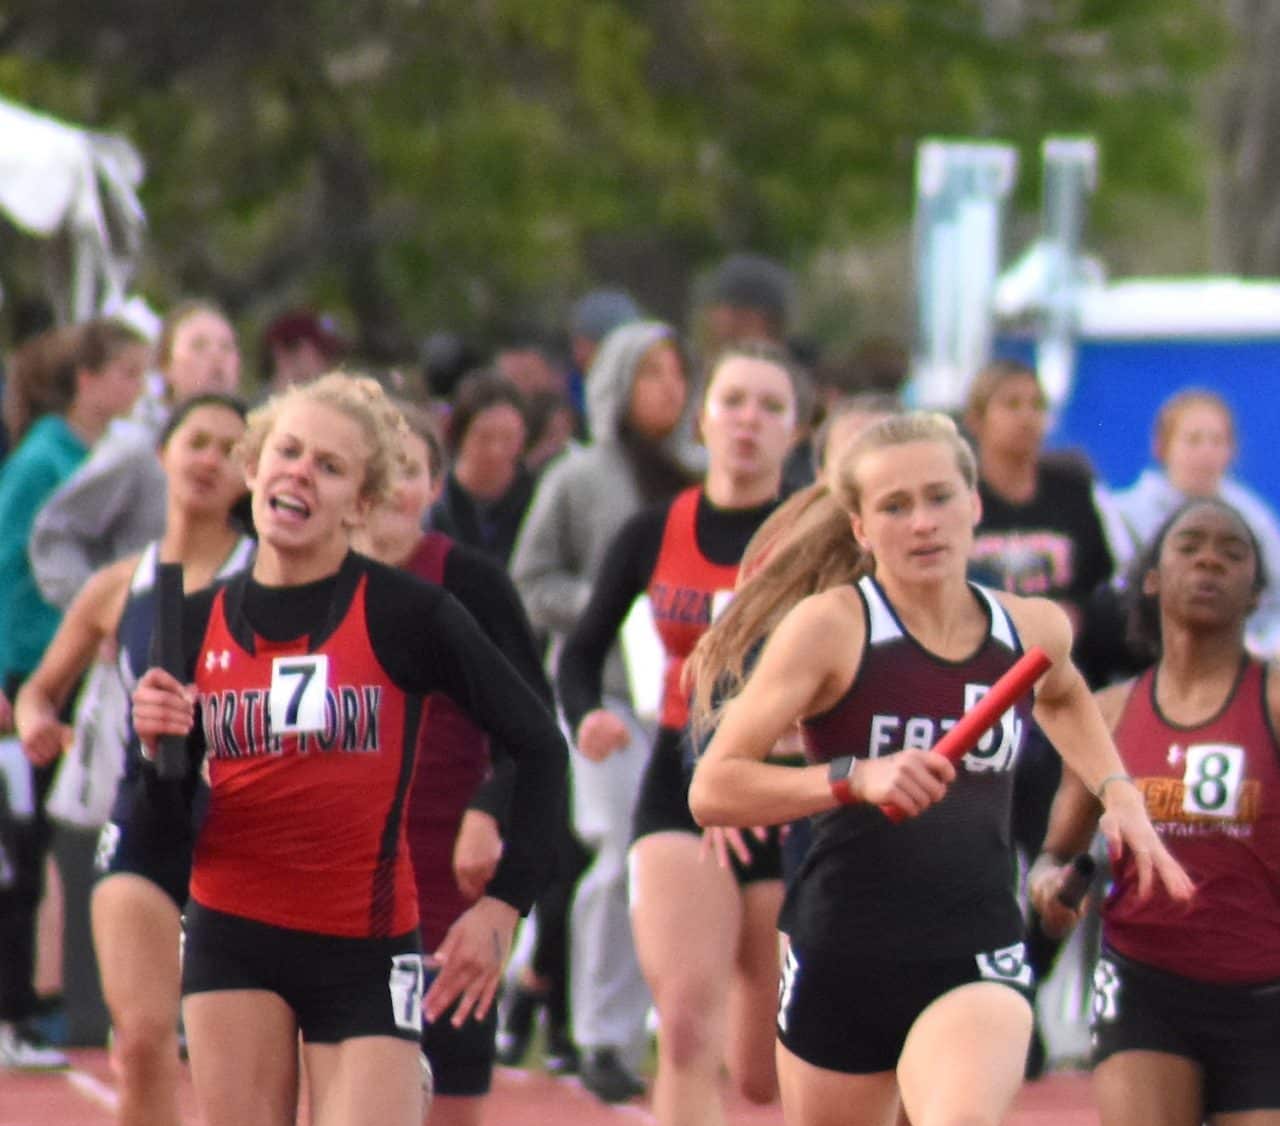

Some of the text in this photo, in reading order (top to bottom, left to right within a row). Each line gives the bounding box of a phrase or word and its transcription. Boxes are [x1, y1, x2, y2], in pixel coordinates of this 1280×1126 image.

[198, 684, 383, 759] ORTH ORK
[279, 663, 317, 727] 7
[1192, 752, 1230, 811] 8
[398, 961, 420, 1022] 7
